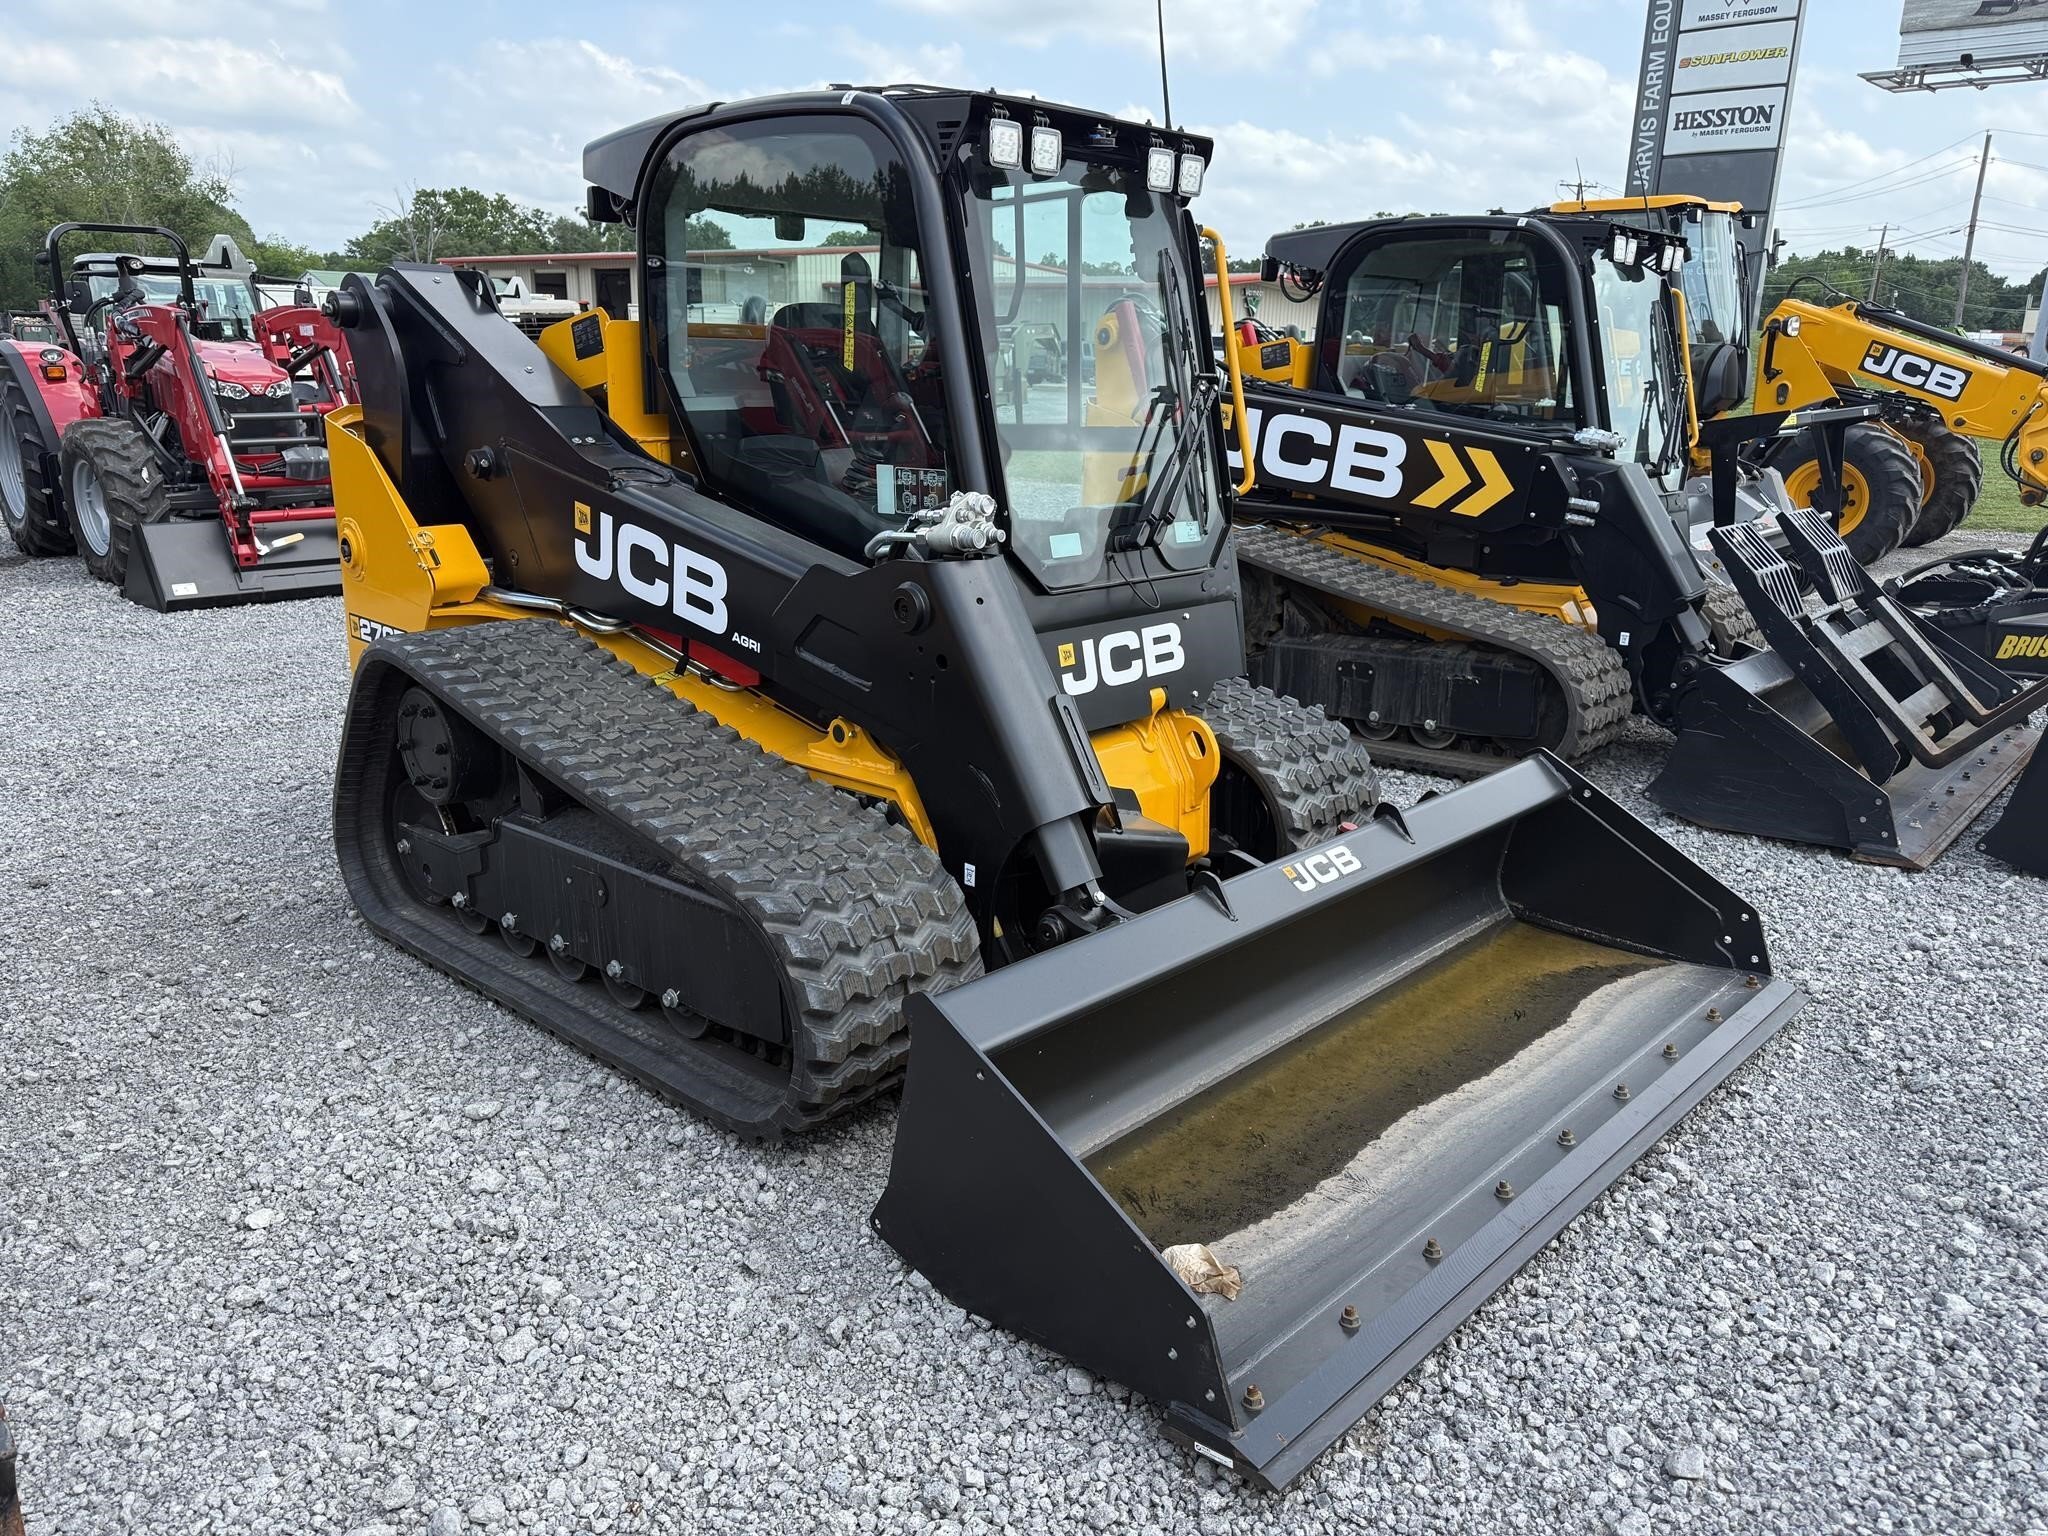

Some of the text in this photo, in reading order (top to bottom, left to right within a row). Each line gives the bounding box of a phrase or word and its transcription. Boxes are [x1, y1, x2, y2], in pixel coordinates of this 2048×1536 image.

[1698, 5, 1778, 23] MASSEY FERGUSON
[1690, 47, 1788, 68] SUNFLOWER
[1633, 0, 1673, 189] JARVIS FARM EQU
[1673, 104, 1776, 132] HESSTON
[1699, 128, 1729, 137] MASSEY
[1730, 125, 1772, 135] FERGUSON
[1863, 348, 1967, 398] JCB
[1227, 407, 1407, 499] JCB
[574, 511, 728, 635] JCB
[731, 631, 761, 654] AGRI
[1061, 622, 1186, 696] JCB
[1293, 845, 1362, 892] JCB
